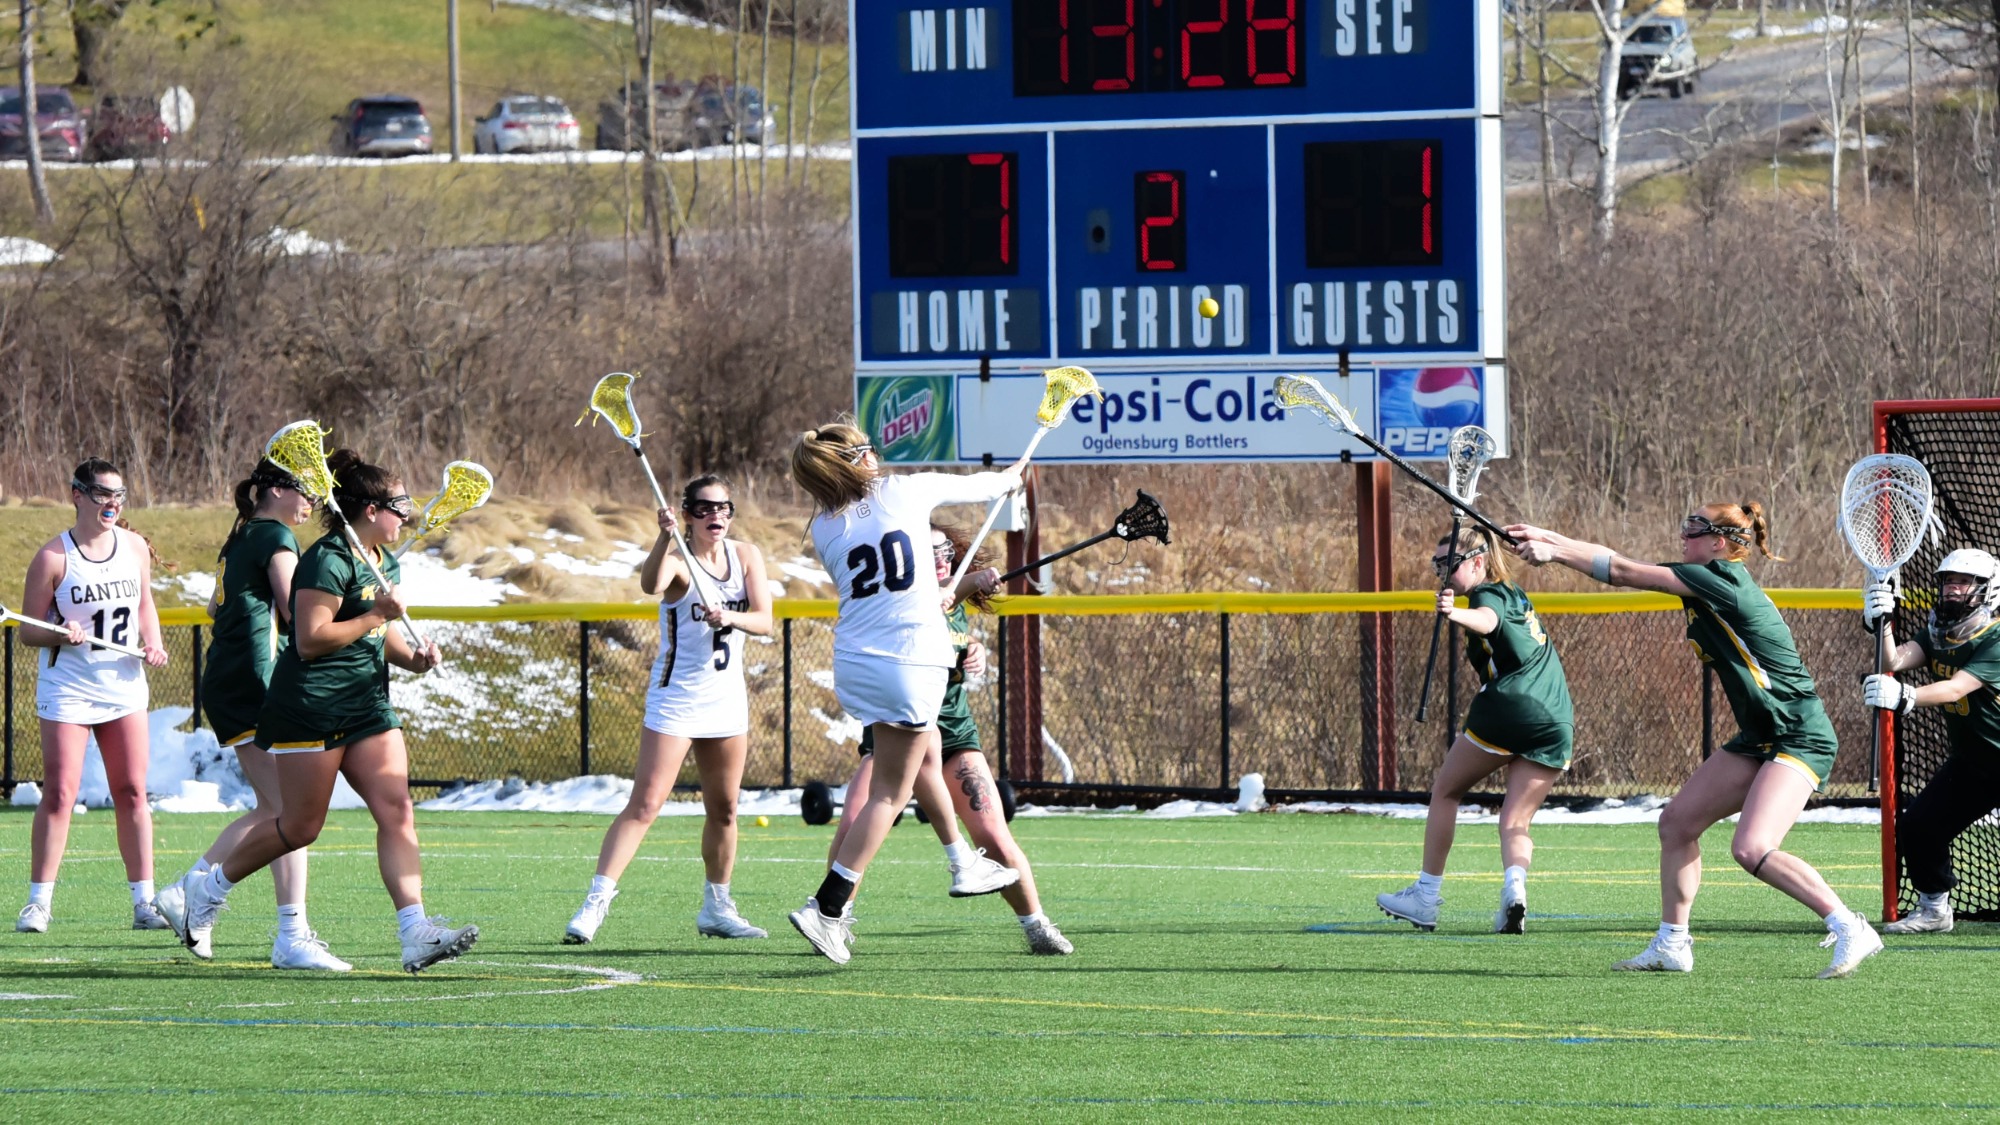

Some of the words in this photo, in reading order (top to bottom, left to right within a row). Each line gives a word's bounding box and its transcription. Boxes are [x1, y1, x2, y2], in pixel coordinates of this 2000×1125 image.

[910, 8, 986, 72] MIN
[1336, 0, 1413, 56] SEC
[966, 153, 1010, 265] 7
[1141, 172, 1179, 270] 2
[1422, 146, 1432, 254] 1
[899, 289, 1011, 353] HOME
[1081, 284, 1245, 349] PERIOD
[1293, 280, 1459, 346] GUESTS
[1071, 376, 1285, 434] epsi-Cola
[1082, 434, 1178, 453] Ogdensburg
[1185, 433, 1249, 449] Bottlers
[1384, 426, 1452, 452] PEP
[856, 503, 872, 519] C
[70, 579, 139, 605] CANTON
[846, 529, 916, 600] 20
[91, 606, 131, 651] 12
[713, 626, 731, 672] 5
